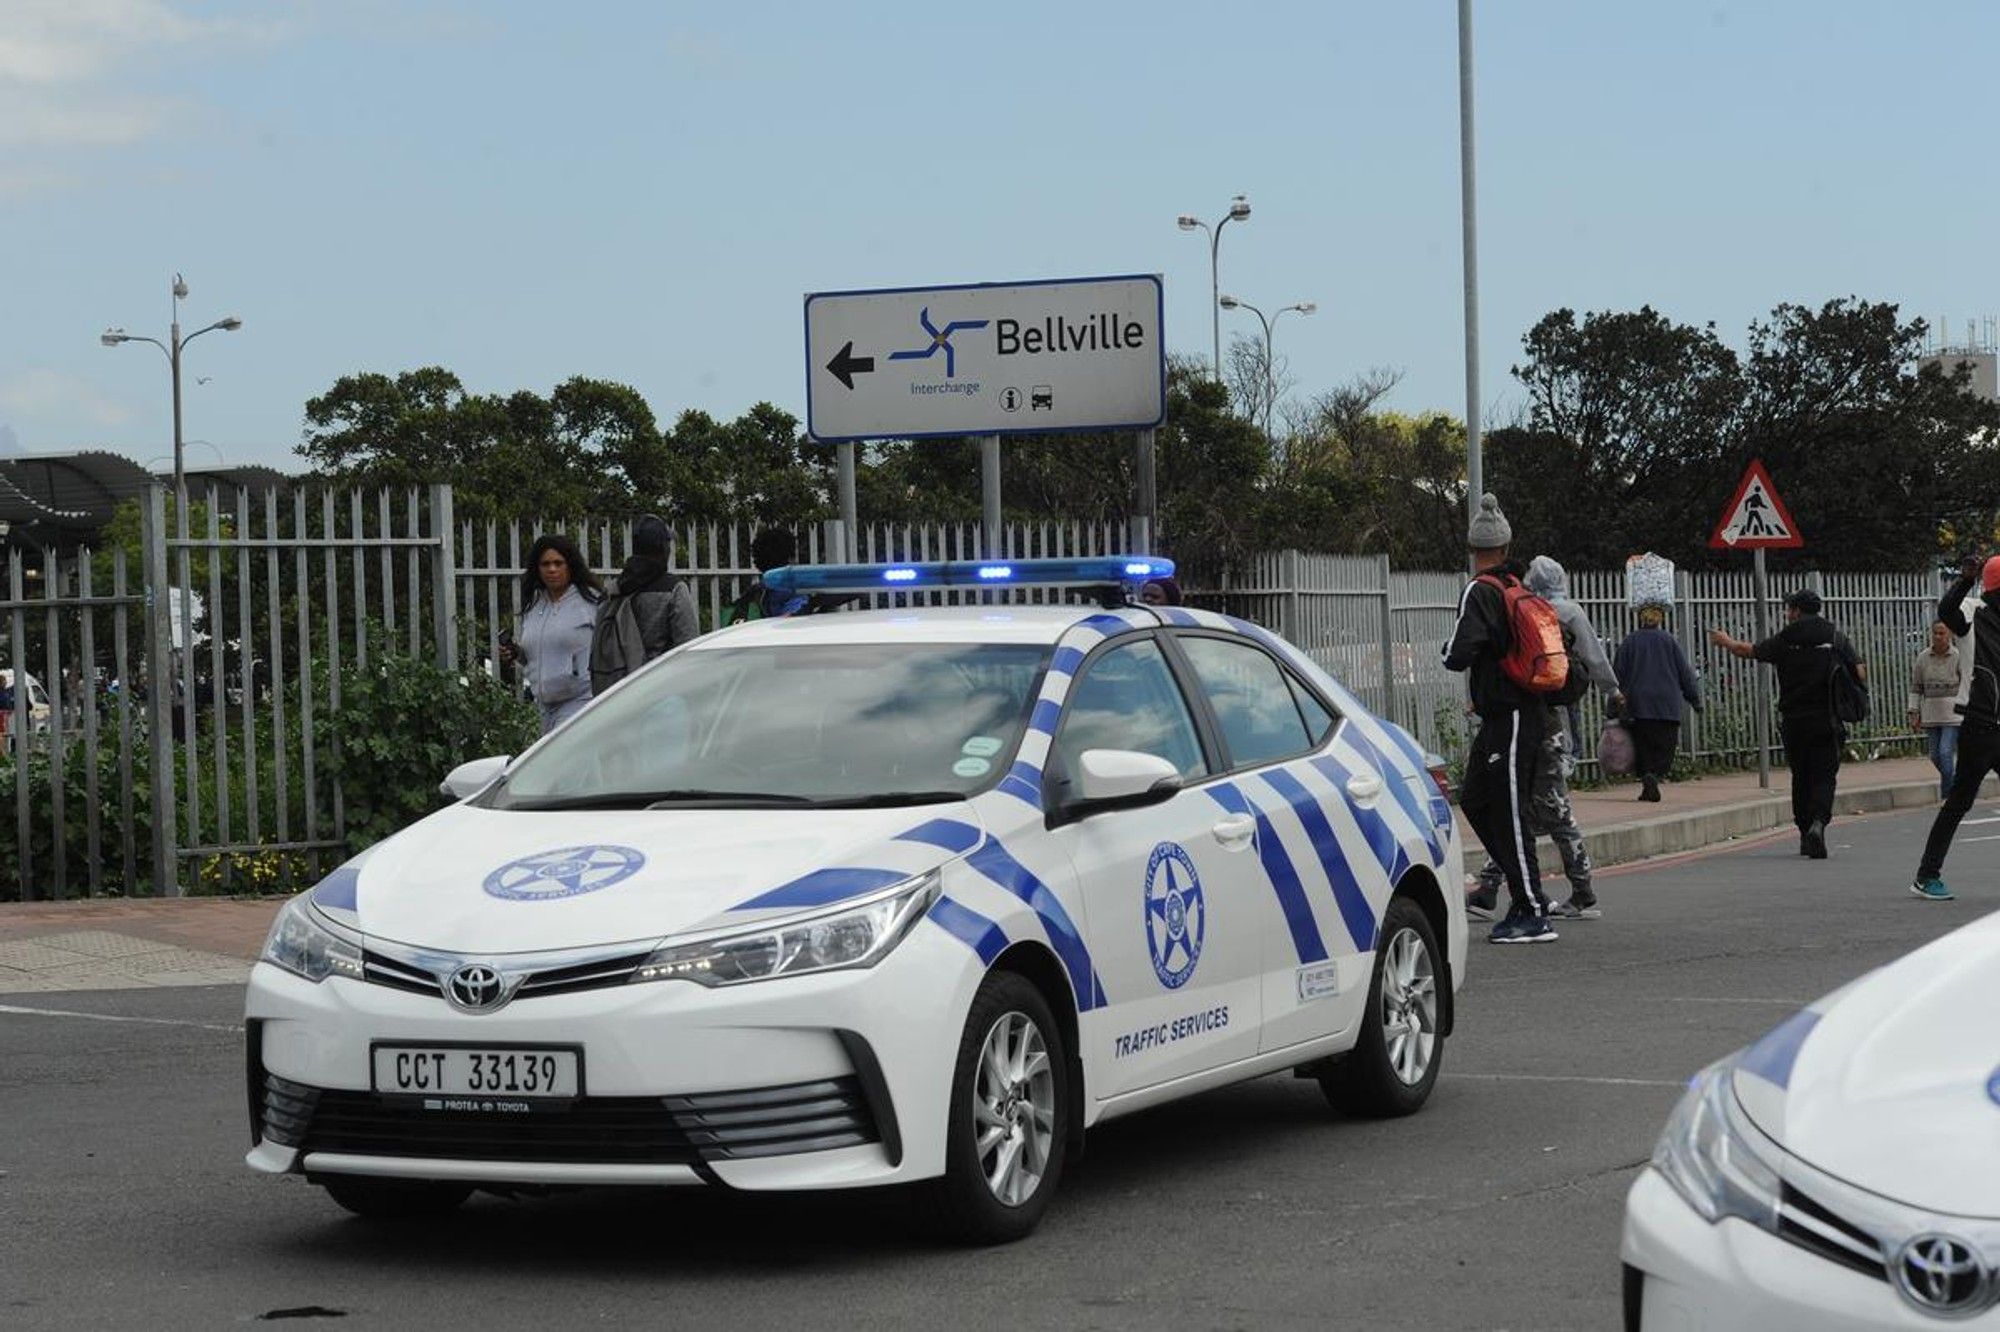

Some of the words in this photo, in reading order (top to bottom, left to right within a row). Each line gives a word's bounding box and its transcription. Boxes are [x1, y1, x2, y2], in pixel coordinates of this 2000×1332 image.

[996, 313, 1144, 355] Bellville
[910, 381, 980, 395] Interchange
[1115, 1024, 1168, 1058] TRAFFIC
[1170, 1006, 1229, 1041] SERVICES
[396, 1053, 446, 1090] CCT
[468, 1054, 557, 1093] 33139
[445, 1100, 479, 1111] PROTEA
[497, 1102, 530, 1112] TOYOTA
